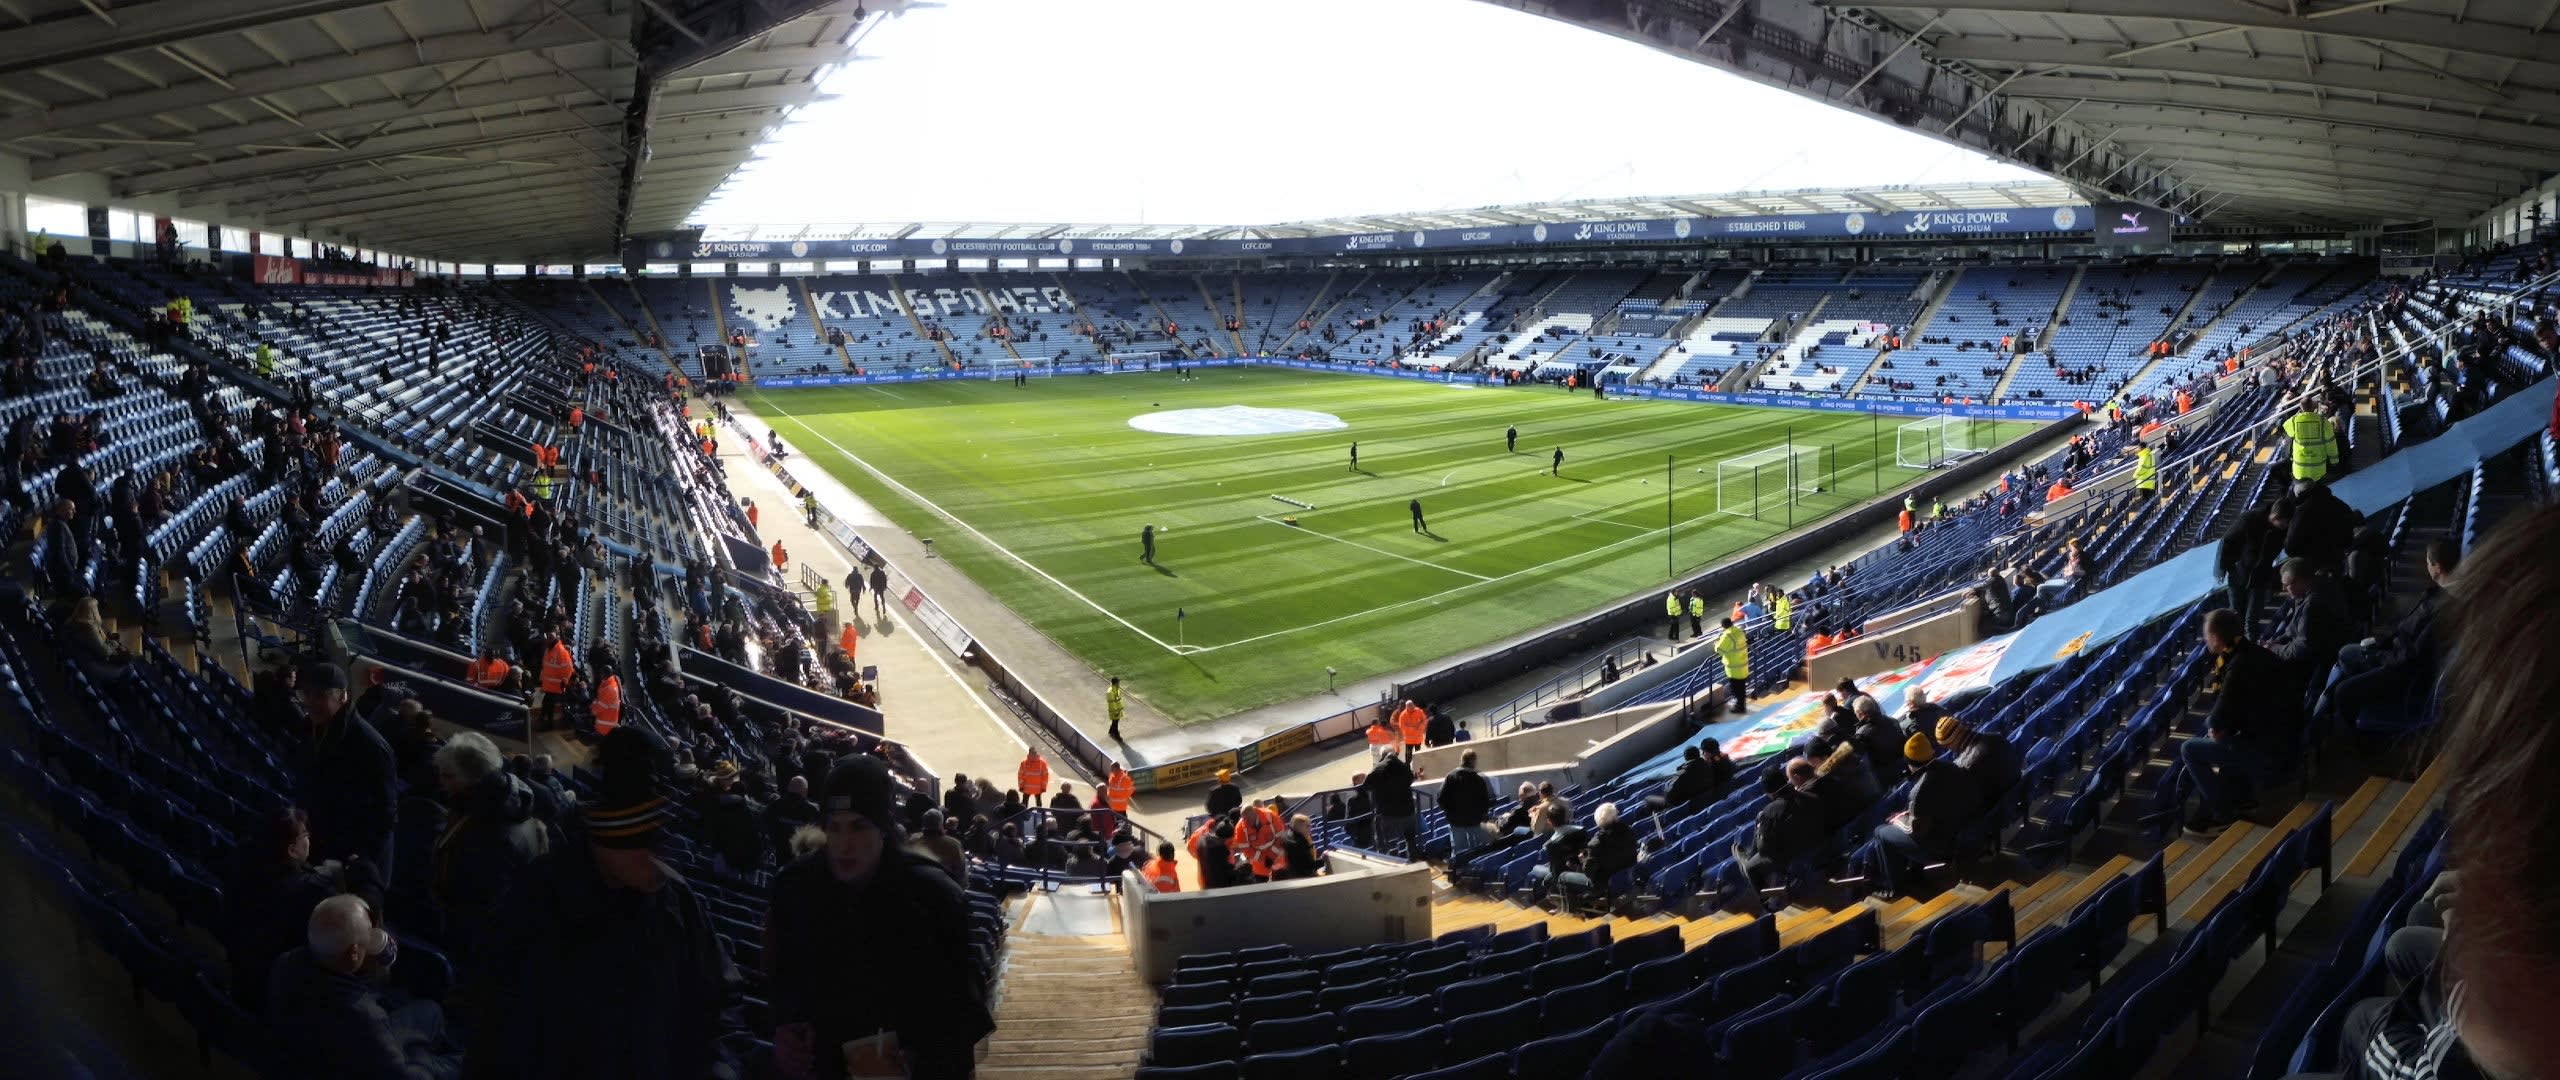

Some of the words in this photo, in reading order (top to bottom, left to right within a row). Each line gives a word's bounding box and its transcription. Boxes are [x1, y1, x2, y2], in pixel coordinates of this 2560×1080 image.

[1933, 213, 1965, 224] KING
[1966, 212, 2010, 223] POWER
[1593, 223, 1616, 233] KING
[1617, 222, 1649, 232] POWER
[1728, 221, 1780, 232] ESTABLISHED
[1951, 224, 1992, 232] STADIUM
[714, 243, 739, 252] KING
